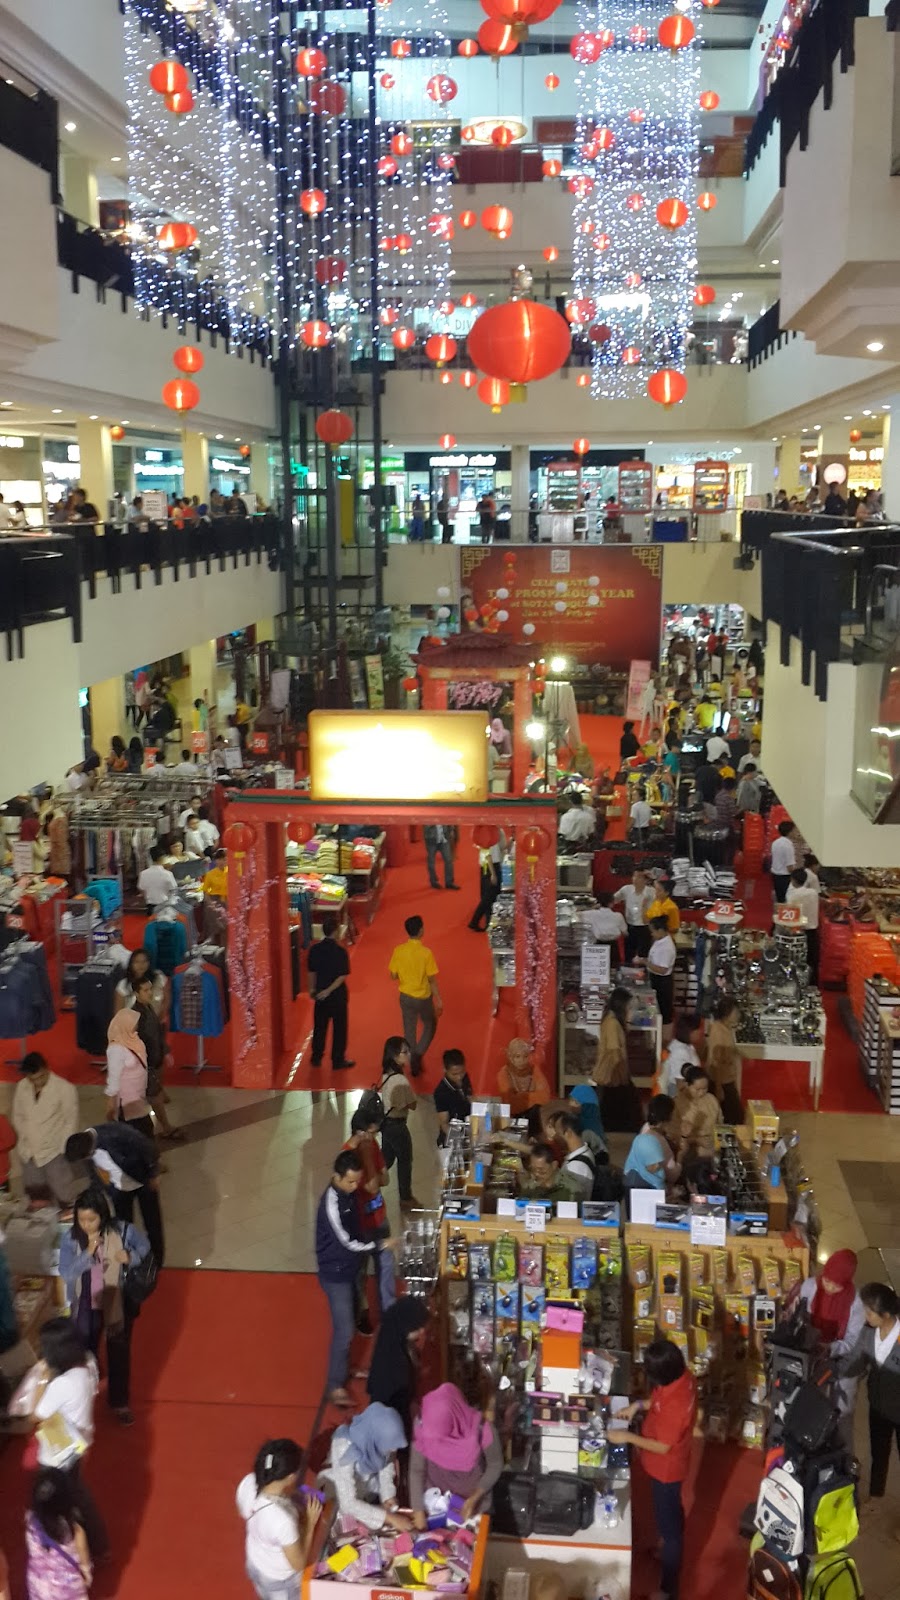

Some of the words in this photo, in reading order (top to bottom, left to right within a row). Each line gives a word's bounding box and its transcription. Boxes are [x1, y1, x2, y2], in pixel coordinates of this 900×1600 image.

[487, 588, 513, 598] TE
[600, 588, 636, 599] YEAR
[566, 600, 606, 609] SQUE
[717, 904, 730, 915] 20
[782, 910, 795, 920] 20
